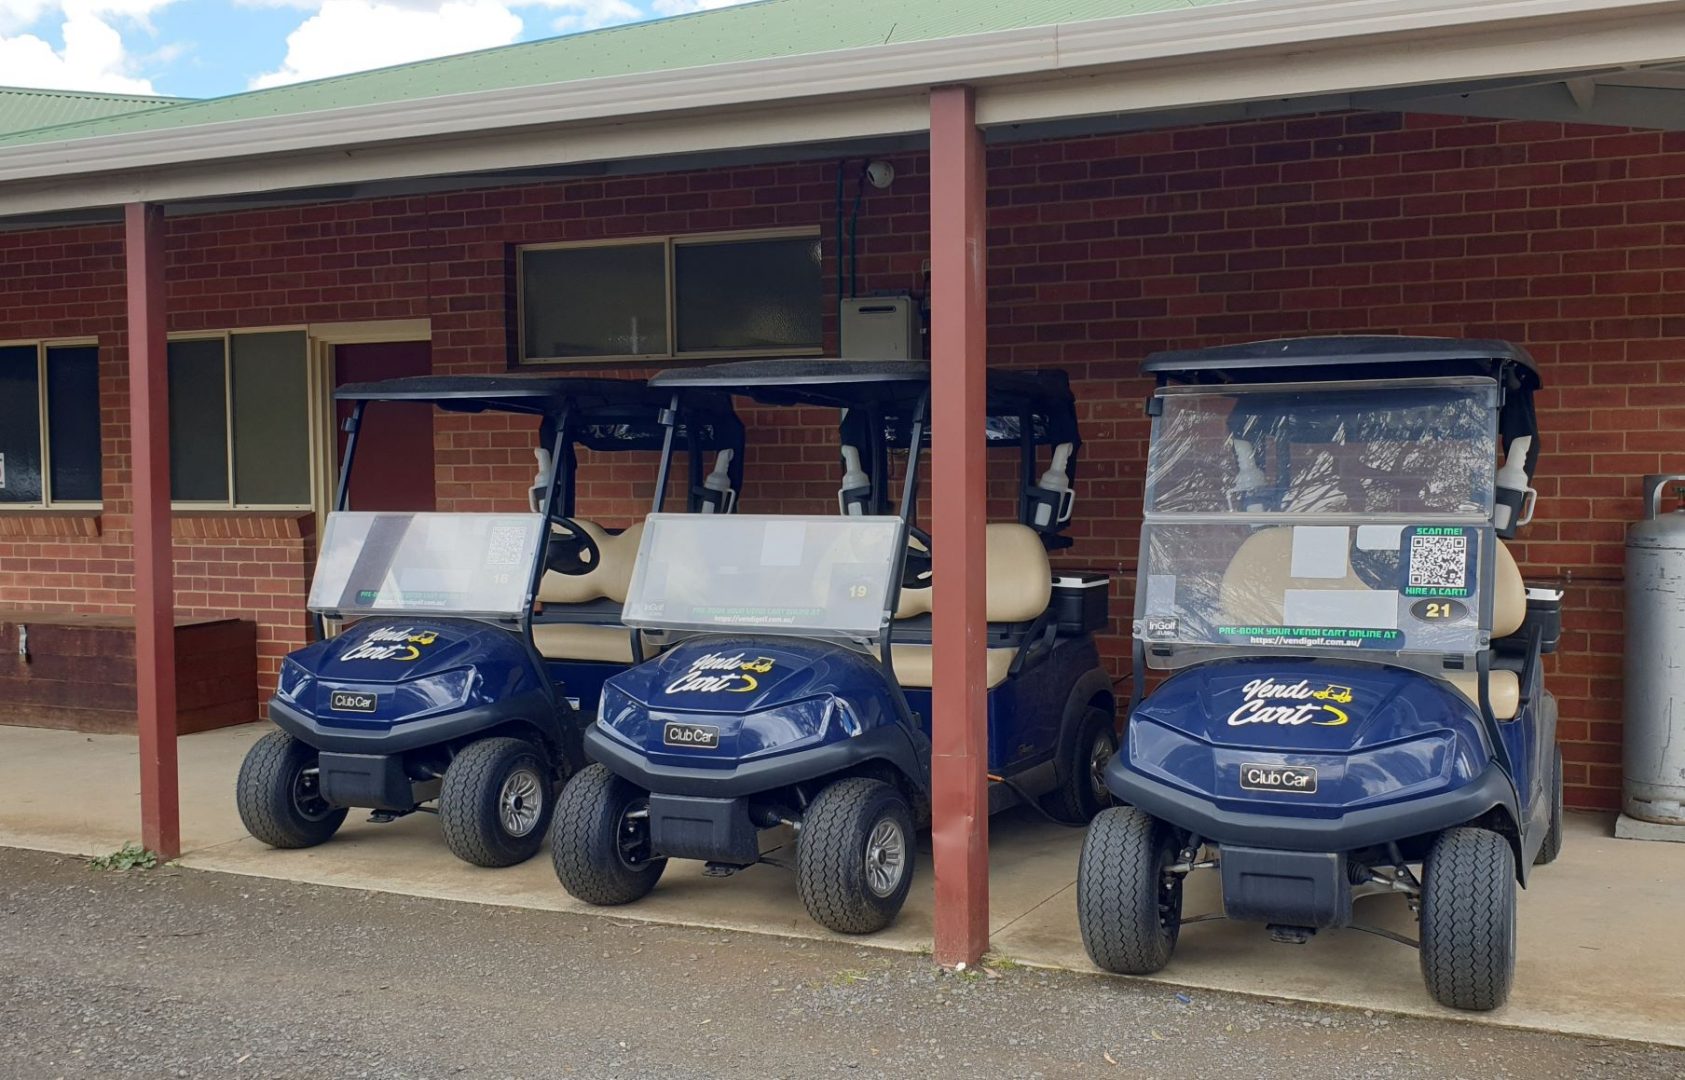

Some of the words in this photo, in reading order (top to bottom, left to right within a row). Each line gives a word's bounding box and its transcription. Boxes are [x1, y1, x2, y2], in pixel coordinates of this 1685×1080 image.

[850, 585, 867, 597] 19
[1405, 587, 1428, 595] HIRE
[1438, 588, 1468, 596] CART!
[1425, 603, 1451, 618] 21
[1149, 621, 1176, 630] InGolf
[1218, 626, 1265, 635] PRE-BOOK
[1266, 627, 1291, 635] YOUR
[1292, 628, 1321, 636] VENDI
[1322, 629, 1347, 637] CART
[1348, 630, 1382, 638] ONLINE
[1250, 636, 1362, 648] https://vendigolf.com.au/
[665, 670, 741, 694] Cart
[1242, 678, 1315, 701] Vendi
[335, 695, 355, 706] Club
[355, 697, 372, 708] Car
[1227, 699, 1322, 726] Cart
[669, 728, 692, 742] Club
[693, 729, 713, 743] Car
[1247, 769, 1281, 785] Club
[1282, 771, 1309, 787] Car
